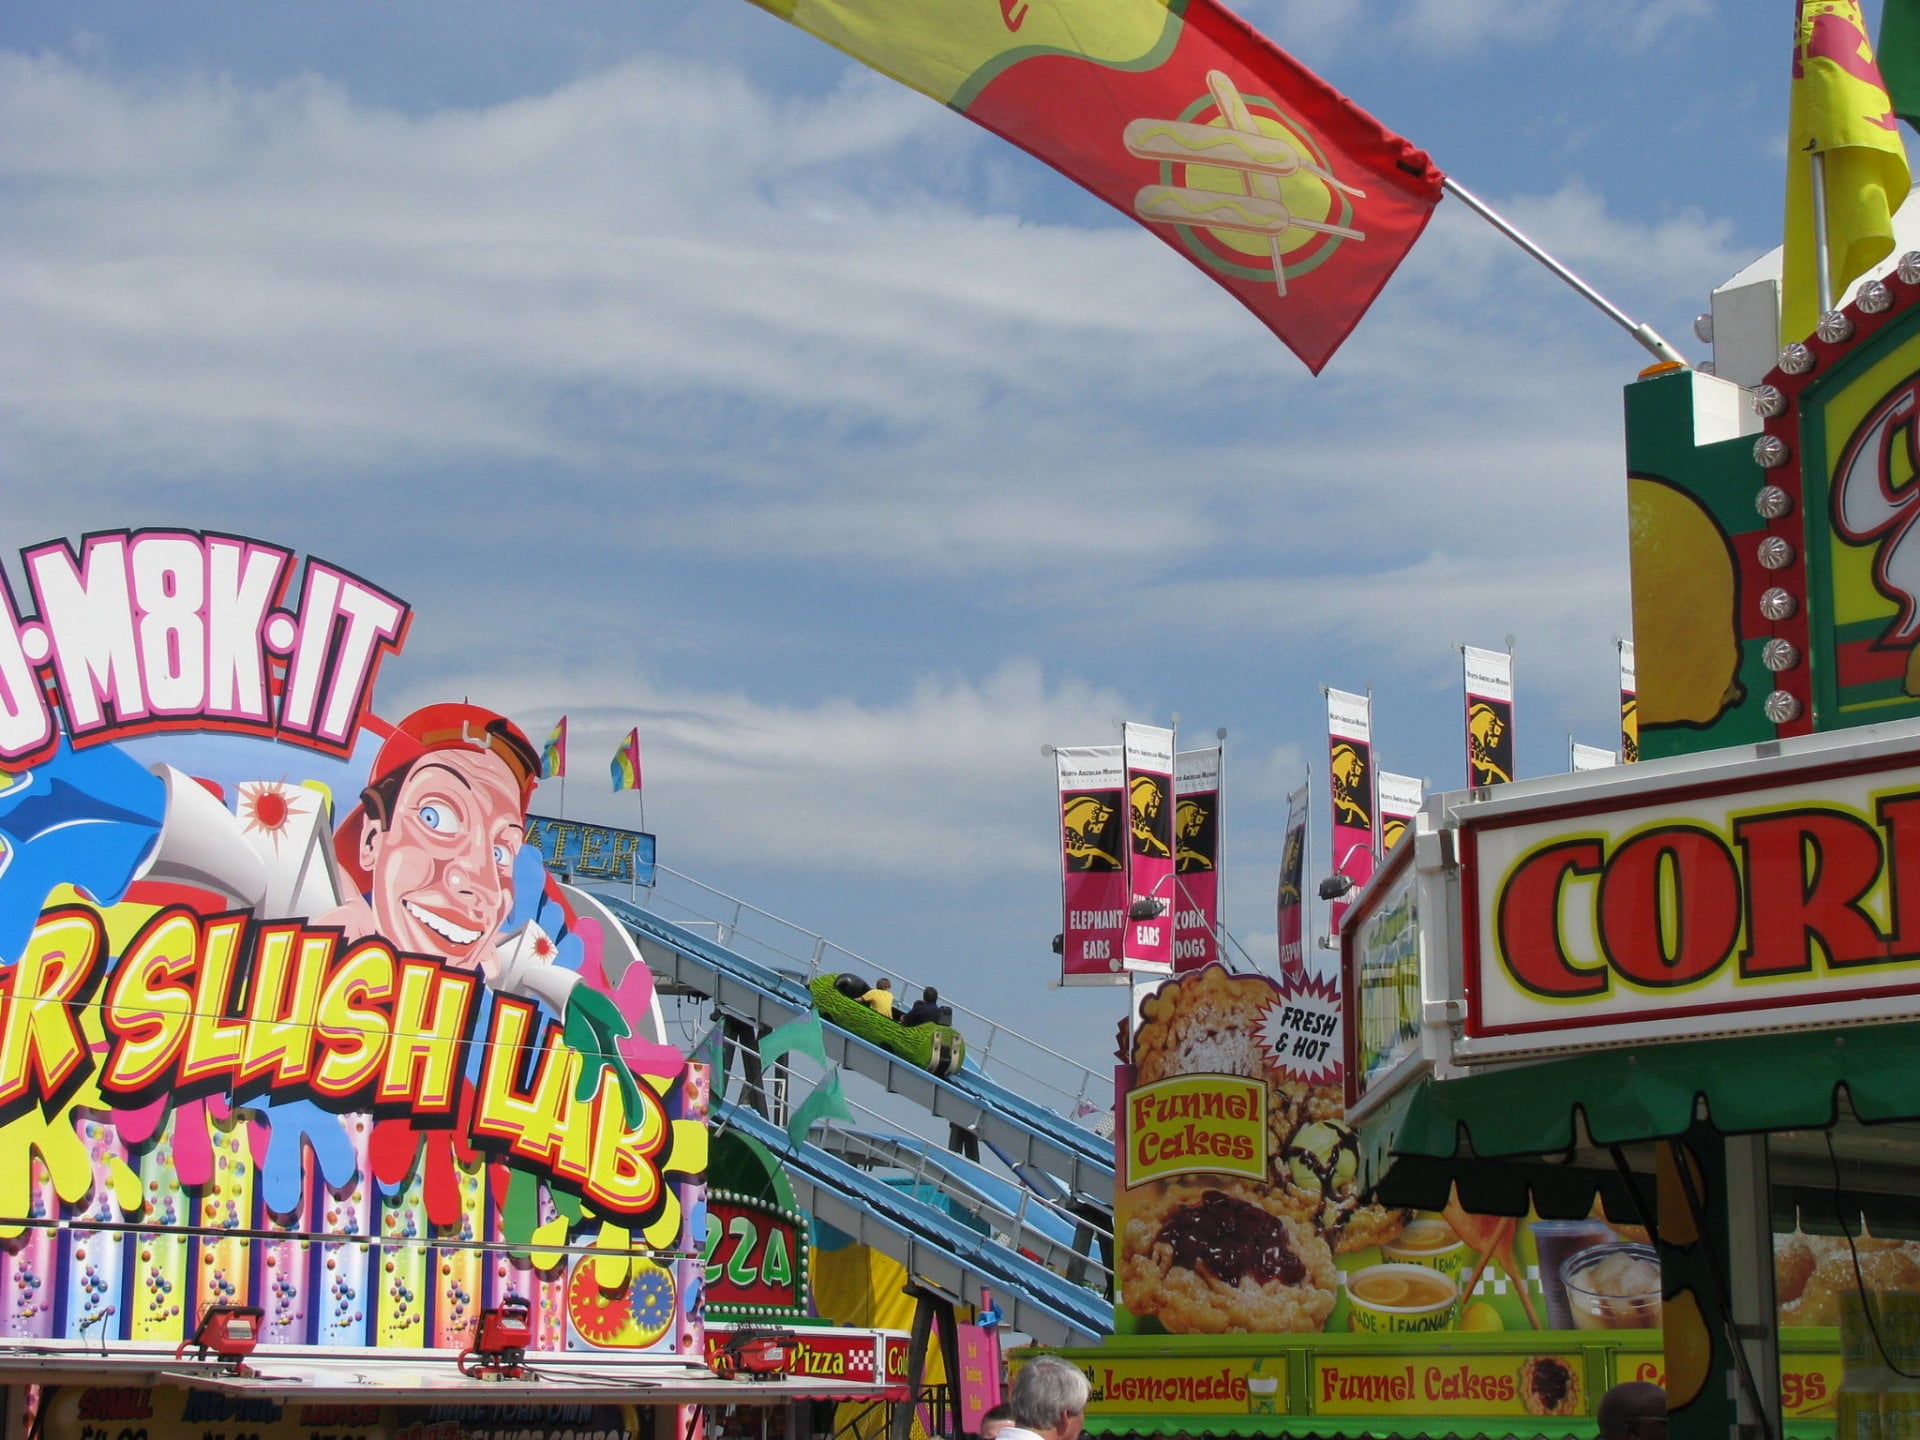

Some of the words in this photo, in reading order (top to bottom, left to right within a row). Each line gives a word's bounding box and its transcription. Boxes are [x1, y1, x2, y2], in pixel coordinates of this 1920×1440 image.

[1070, 910, 1123, 930] ELEPHANT
[1174, 909, 1205, 929] CORN
[1083, 940, 1110, 960] EARS
[1136, 925, 1160, 947] EARS
[1176, 938, 1206, 960] DOGS
[1281, 1006, 1338, 1038] FRESH
[101, 904, 480, 1118] SLUSH
[472, 990, 670, 1216] LAB
[1275, 1032, 1289, 1053] &
[1292, 1036, 1330, 1062] HOT
[1132, 1087, 1260, 1134] Funnel
[1138, 1123, 1255, 1167] Cakes
[789, 1342, 845, 1375] Pizza
[1104, 1368, 1248, 1402] Lemonade
[1322, 1366, 1416, 1403] Funnel
[1424, 1366, 1515, 1401] Cakes
